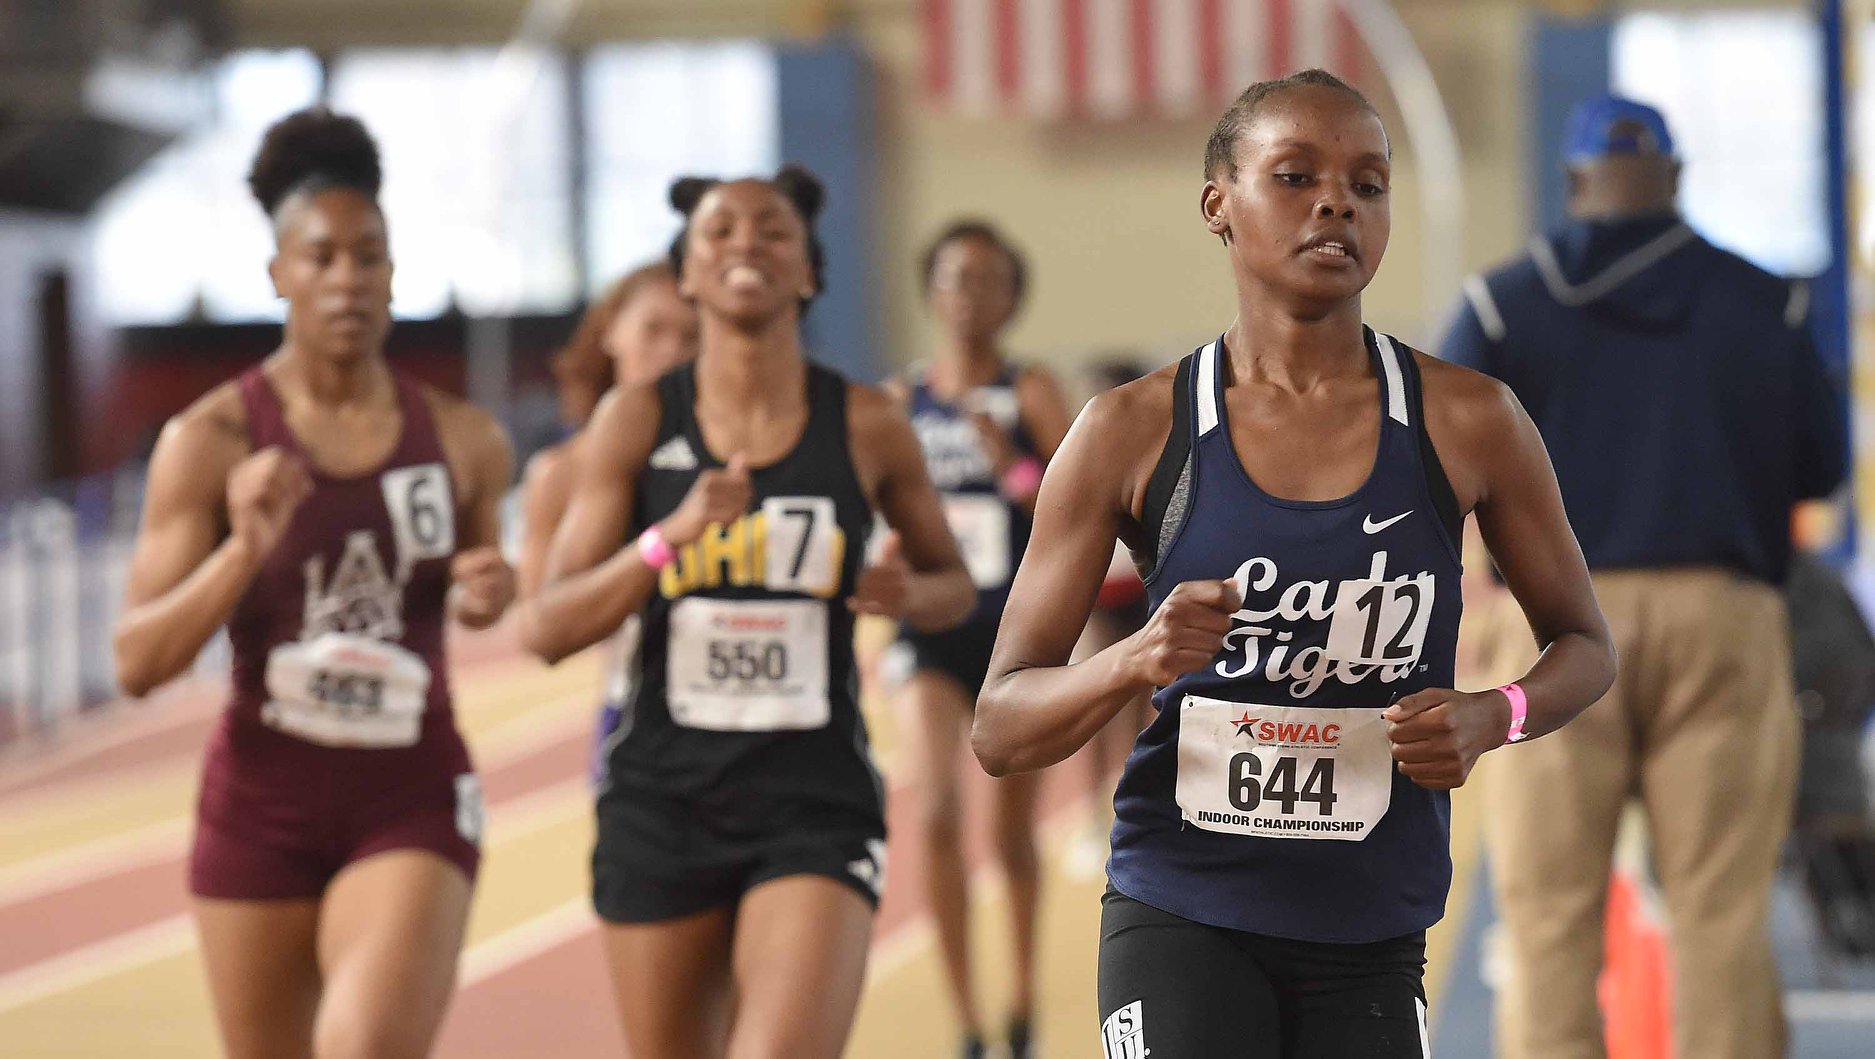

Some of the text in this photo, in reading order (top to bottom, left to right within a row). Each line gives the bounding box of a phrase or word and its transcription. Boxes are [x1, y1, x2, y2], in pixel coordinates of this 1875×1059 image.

[408, 475, 441, 548] 6
[783, 508, 815, 579] 7
[1231, 551, 1435, 623] La
[1355, 584, 1421, 660] 12
[708, 641, 787, 680] 550
[1258, 720, 1341, 744] SWAC
[1228, 751, 1338, 816] 644
[1198, 810, 1365, 832] INDOOR CHAMPIONSHIP
